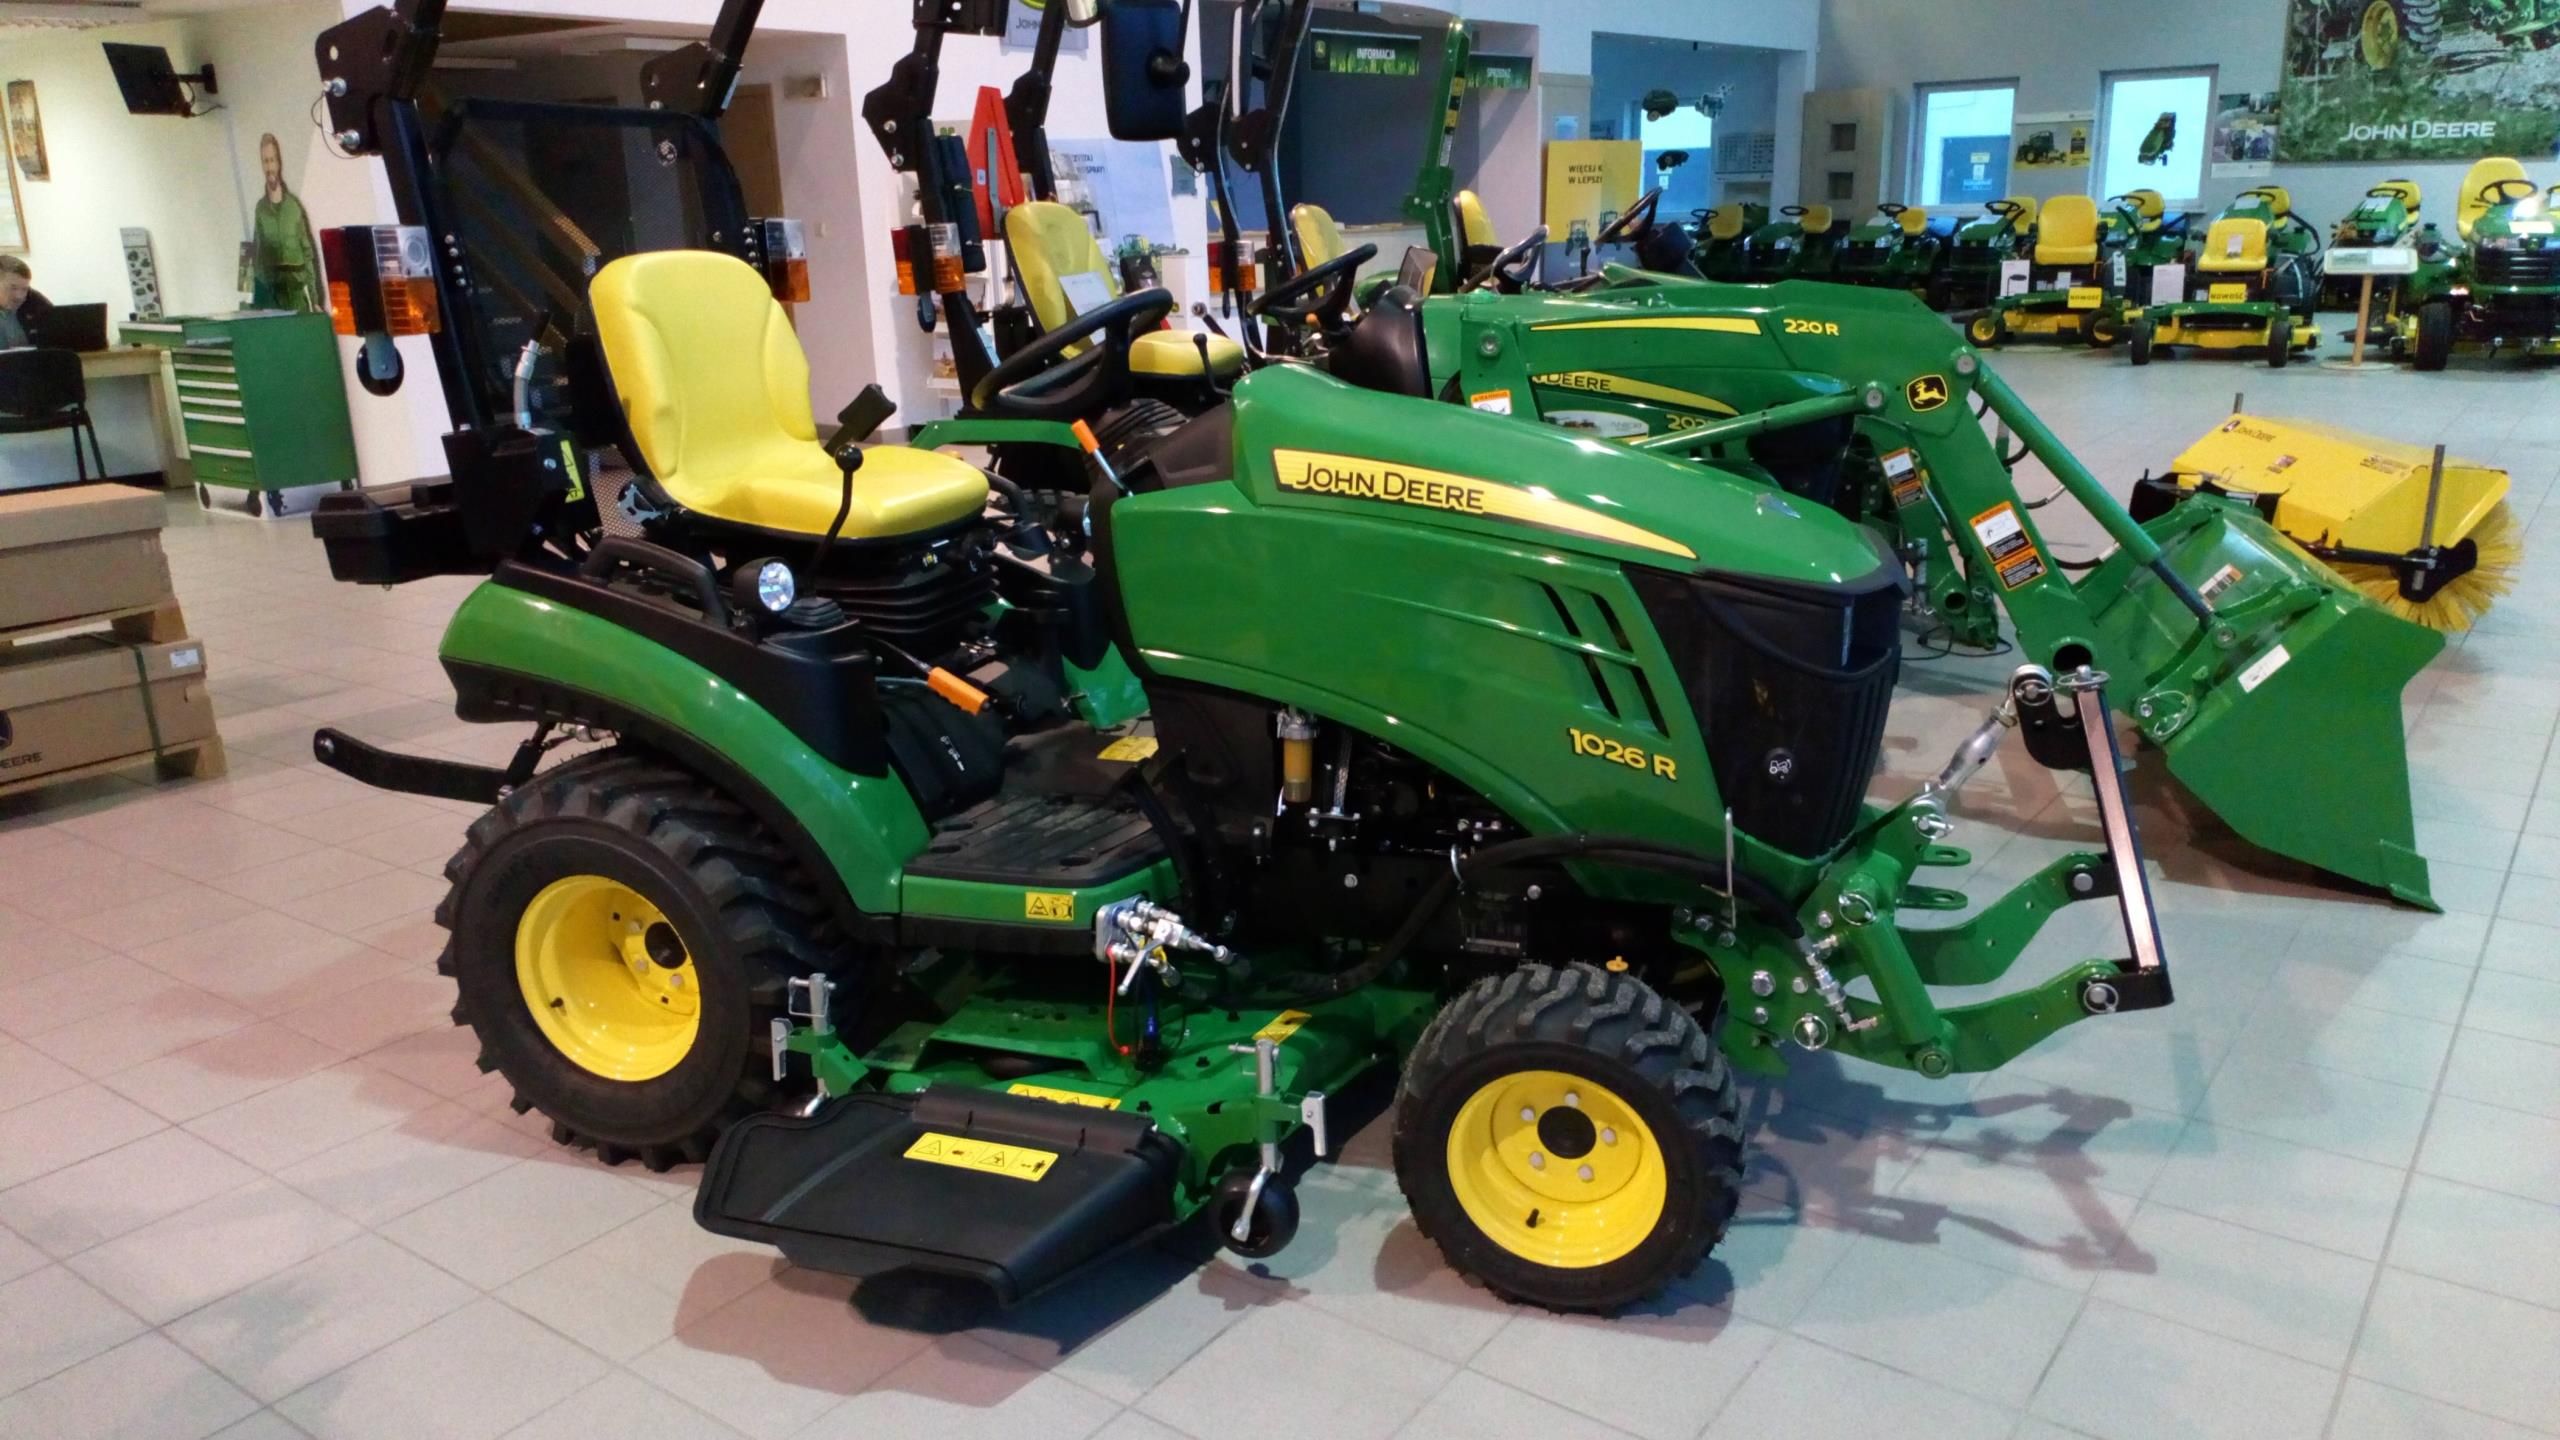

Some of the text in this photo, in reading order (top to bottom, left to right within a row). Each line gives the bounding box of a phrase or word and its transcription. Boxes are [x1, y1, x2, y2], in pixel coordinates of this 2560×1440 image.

[2339, 121, 2497, 142] JOHN DEERE
[1568, 164, 1596, 175] WIĘCEJ
[1568, 176, 1576, 184] W
[1783, 319, 1840, 336] 220 R
[1547, 372, 1611, 391] DEERE
[1296, 463, 1485, 510] JOHN DEERE
[1568, 728, 1677, 780] 1026 R
